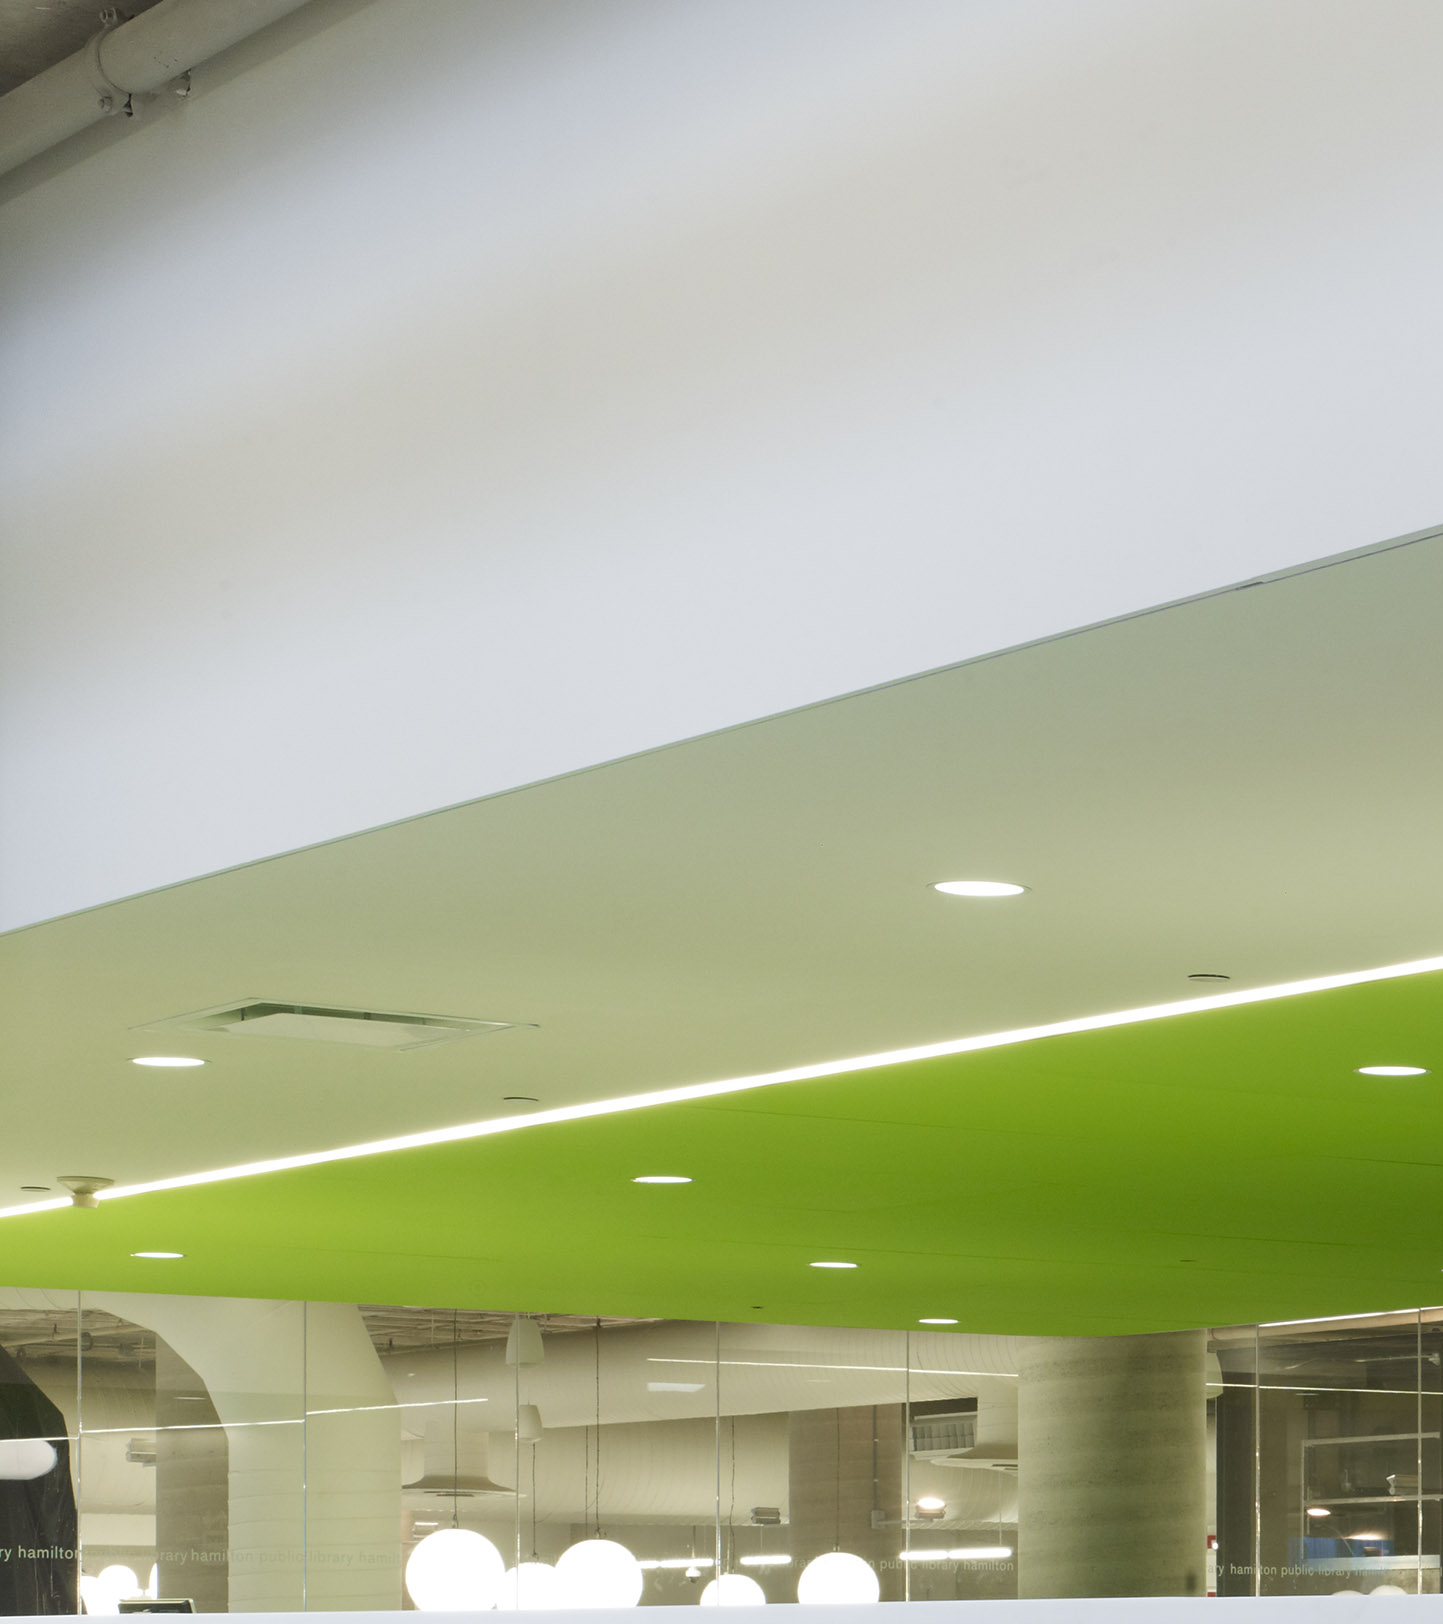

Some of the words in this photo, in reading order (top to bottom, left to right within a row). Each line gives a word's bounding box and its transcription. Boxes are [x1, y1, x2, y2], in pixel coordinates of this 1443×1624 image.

[359, 1552, 401, 1565] hamilt
[964, 1557, 1014, 1571] hamilton
[1230, 1563, 1277, 1576] hamiton
[1281, 1565, 1314, 1577] public
